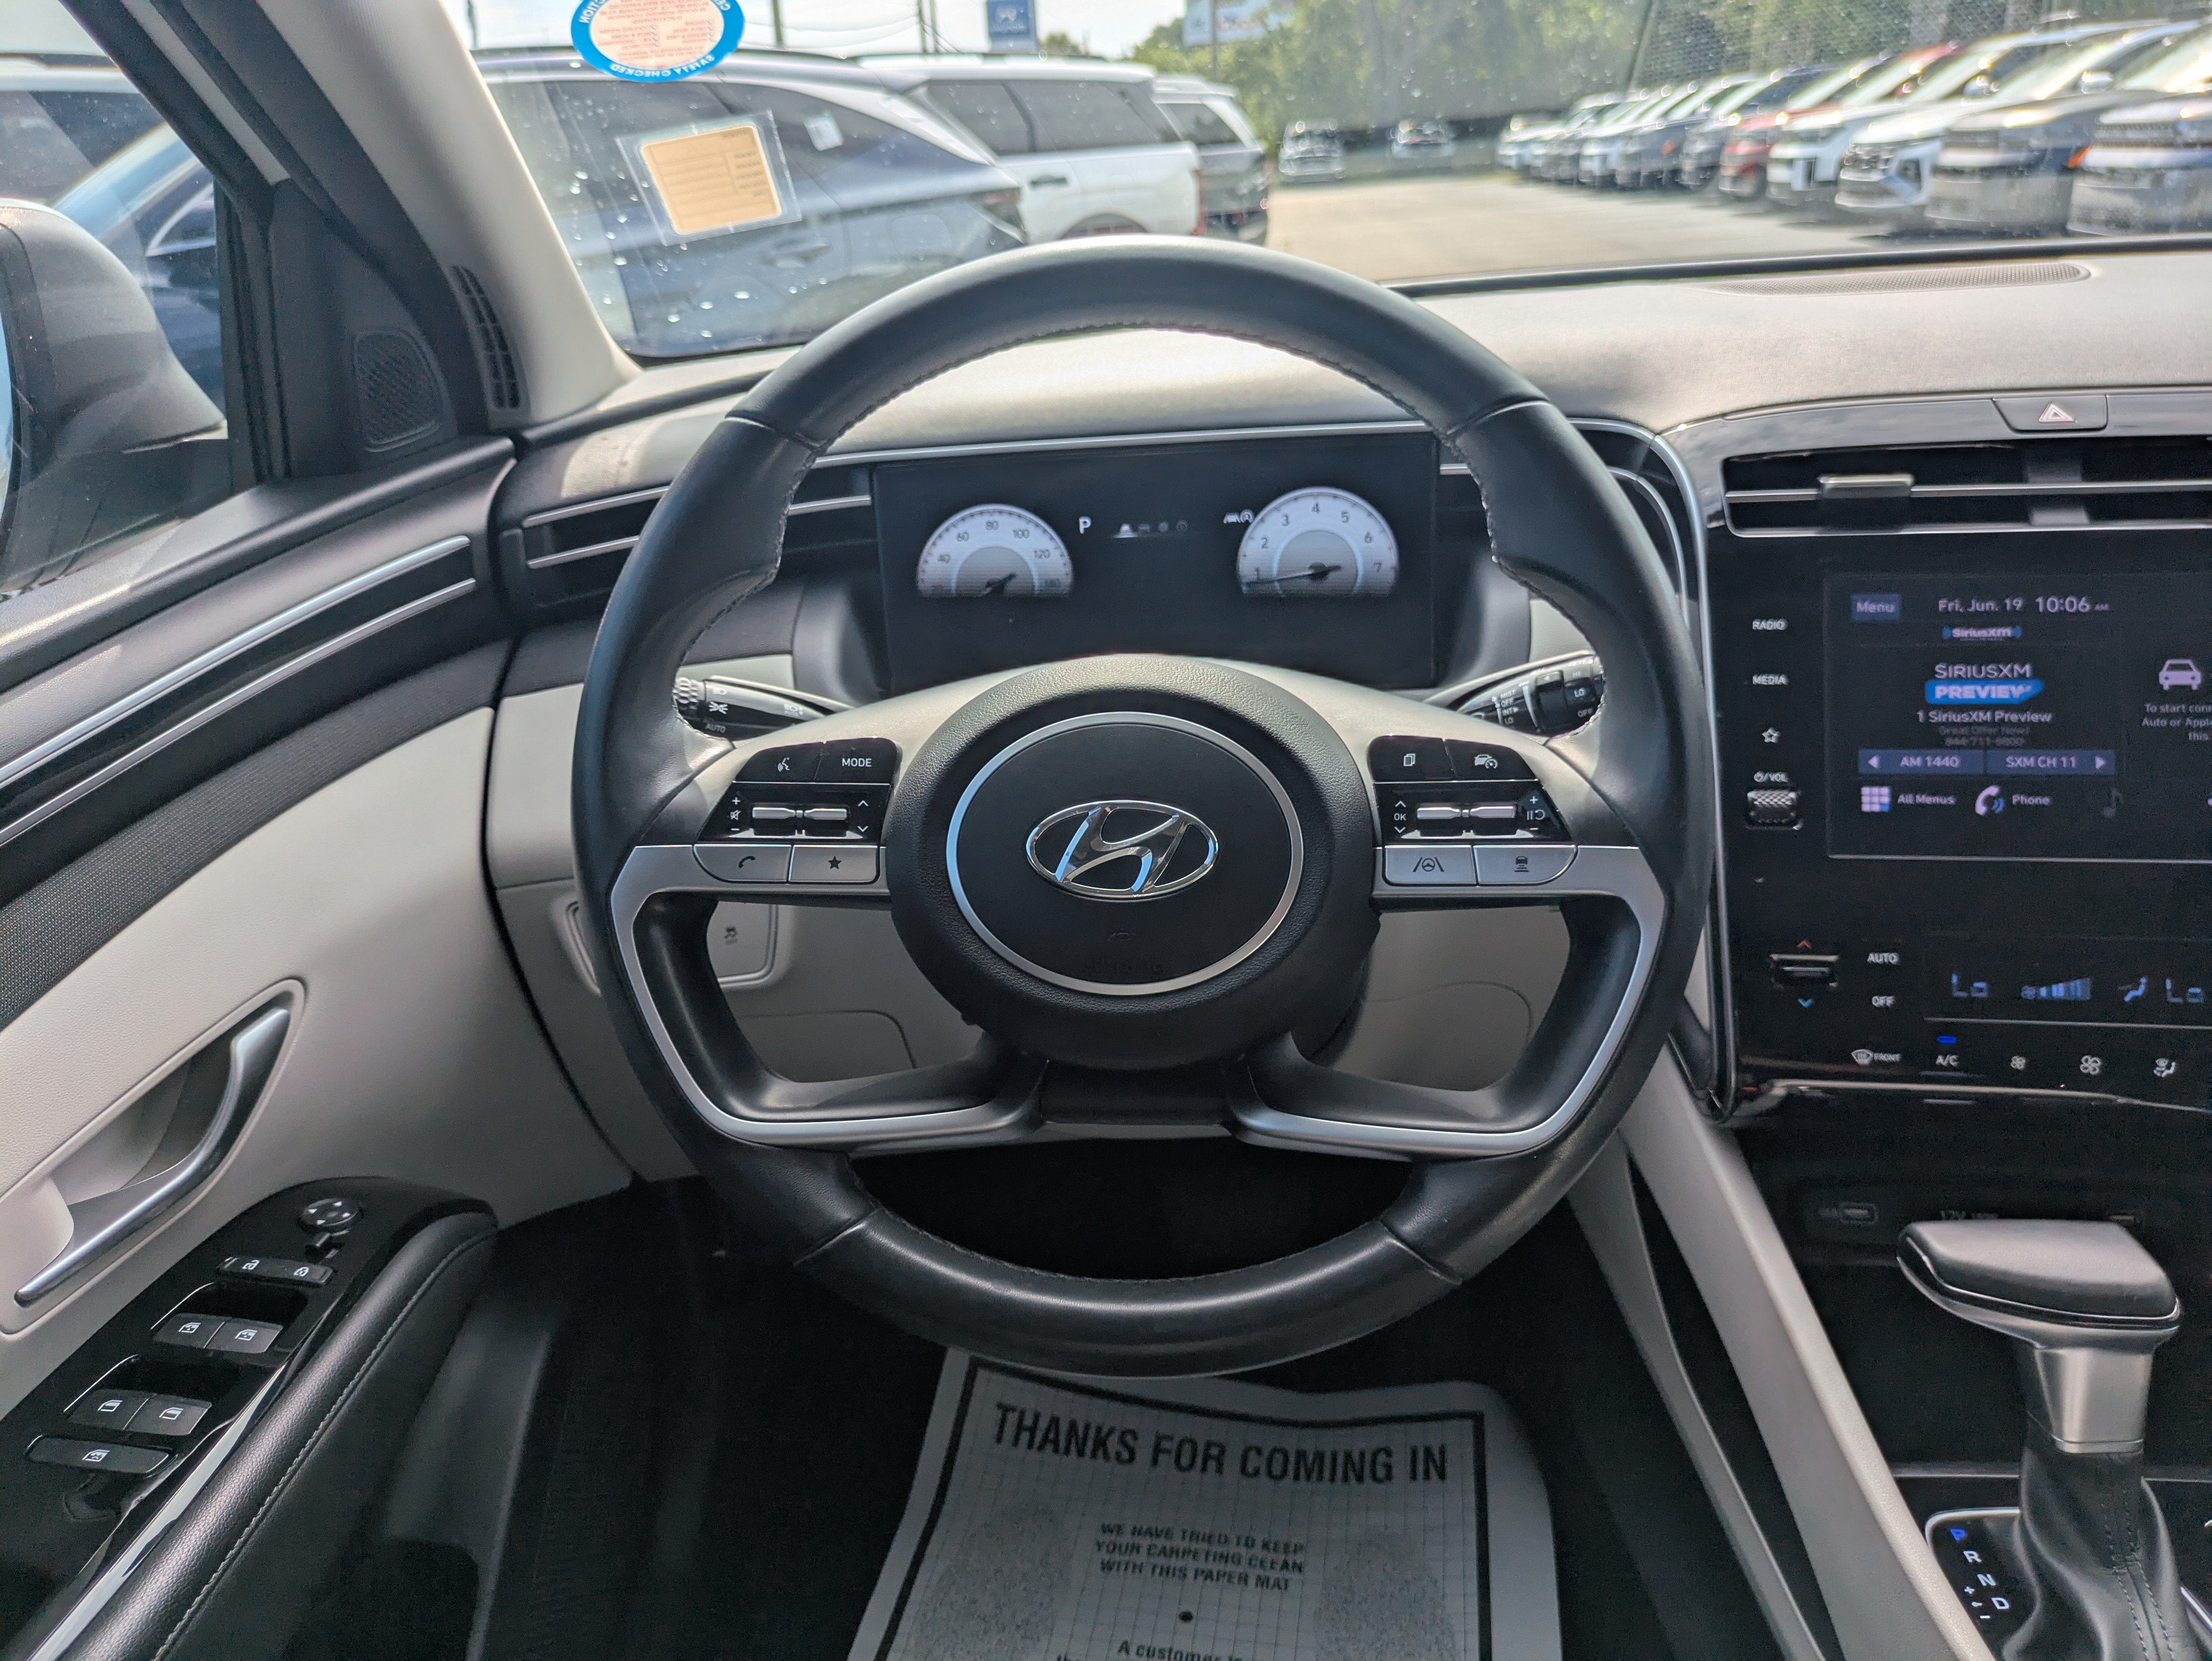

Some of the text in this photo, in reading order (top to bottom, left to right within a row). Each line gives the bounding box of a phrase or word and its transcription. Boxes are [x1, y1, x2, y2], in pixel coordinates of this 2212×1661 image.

[1312, 503, 1320, 513] 4
[1282, 515, 1290, 526] 3
[1341, 511, 1349, 523] 5
[985, 521, 999, 531] 80
[1079, 516, 1091, 533] P
[957, 532, 970, 542] 60
[1013, 529, 1030, 539] 100
[1364, 532, 1372, 544] 6
[1261, 537, 1268, 549] 2
[938, 554, 951, 564] 40
[1034, 549, 1051, 559] 120
[1373, 562, 1382, 573] 7
[1856, 601, 1895, 614] Menu
[1938, 598, 1964, 612] Fri.
[1967, 598, 1999, 612] Jun.
[2004, 598, 2023, 611] 19
[2035, 596, 2091, 613] 10:06
[1752, 619, 1788, 631] RADIO
[1935, 663, 2031, 679] SIRIUSXM
[1752, 674, 1789, 685] MEDIA
[1500, 689, 1516, 699] MIST
[1574, 687, 1585, 698] LO
[1935, 684, 2033, 699] PREVIEW
[1501, 698, 1514, 708] OFF
[2159, 704, 2186, 713] start
[1929, 711, 1991, 722] SiriusXM
[1995, 711, 2053, 723] Preview
[2142, 717, 2167, 727] Auto
[705, 723, 726, 733] AUTO
[841, 757, 872, 767] MODE
[1899, 756, 1960, 767] AM 1440
[2006, 756, 2077, 767] SXM CH 11
[1915, 794, 1956, 805] Menus
[2012, 794, 2051, 806] Phone
[1394, 813, 1406, 822] OK
[1867, 952, 1900, 964] AUTO
[1871, 996, 1896, 1007] OFF
[1873, 1052, 1901, 1062] FRONT
[1936, 1054, 1958, 1067] A/C
[995, 1401, 1447, 1483] THANKS FOR COMING IN
[1101, 1523, 1304, 1554] WE HAVE TRIED TO KEEP
[1096, 1541, 1304, 1573] YOUR CARPETING CLEAN
[1963, 1550, 1982, 1563] R
[1100, 1559, 1290, 1591] WITH THIS PAPER MAT
[1977, 1573, 1996, 1587] N
[1991, 1597, 2010, 1610] D
[1117, 1639, 1130, 1655] A
